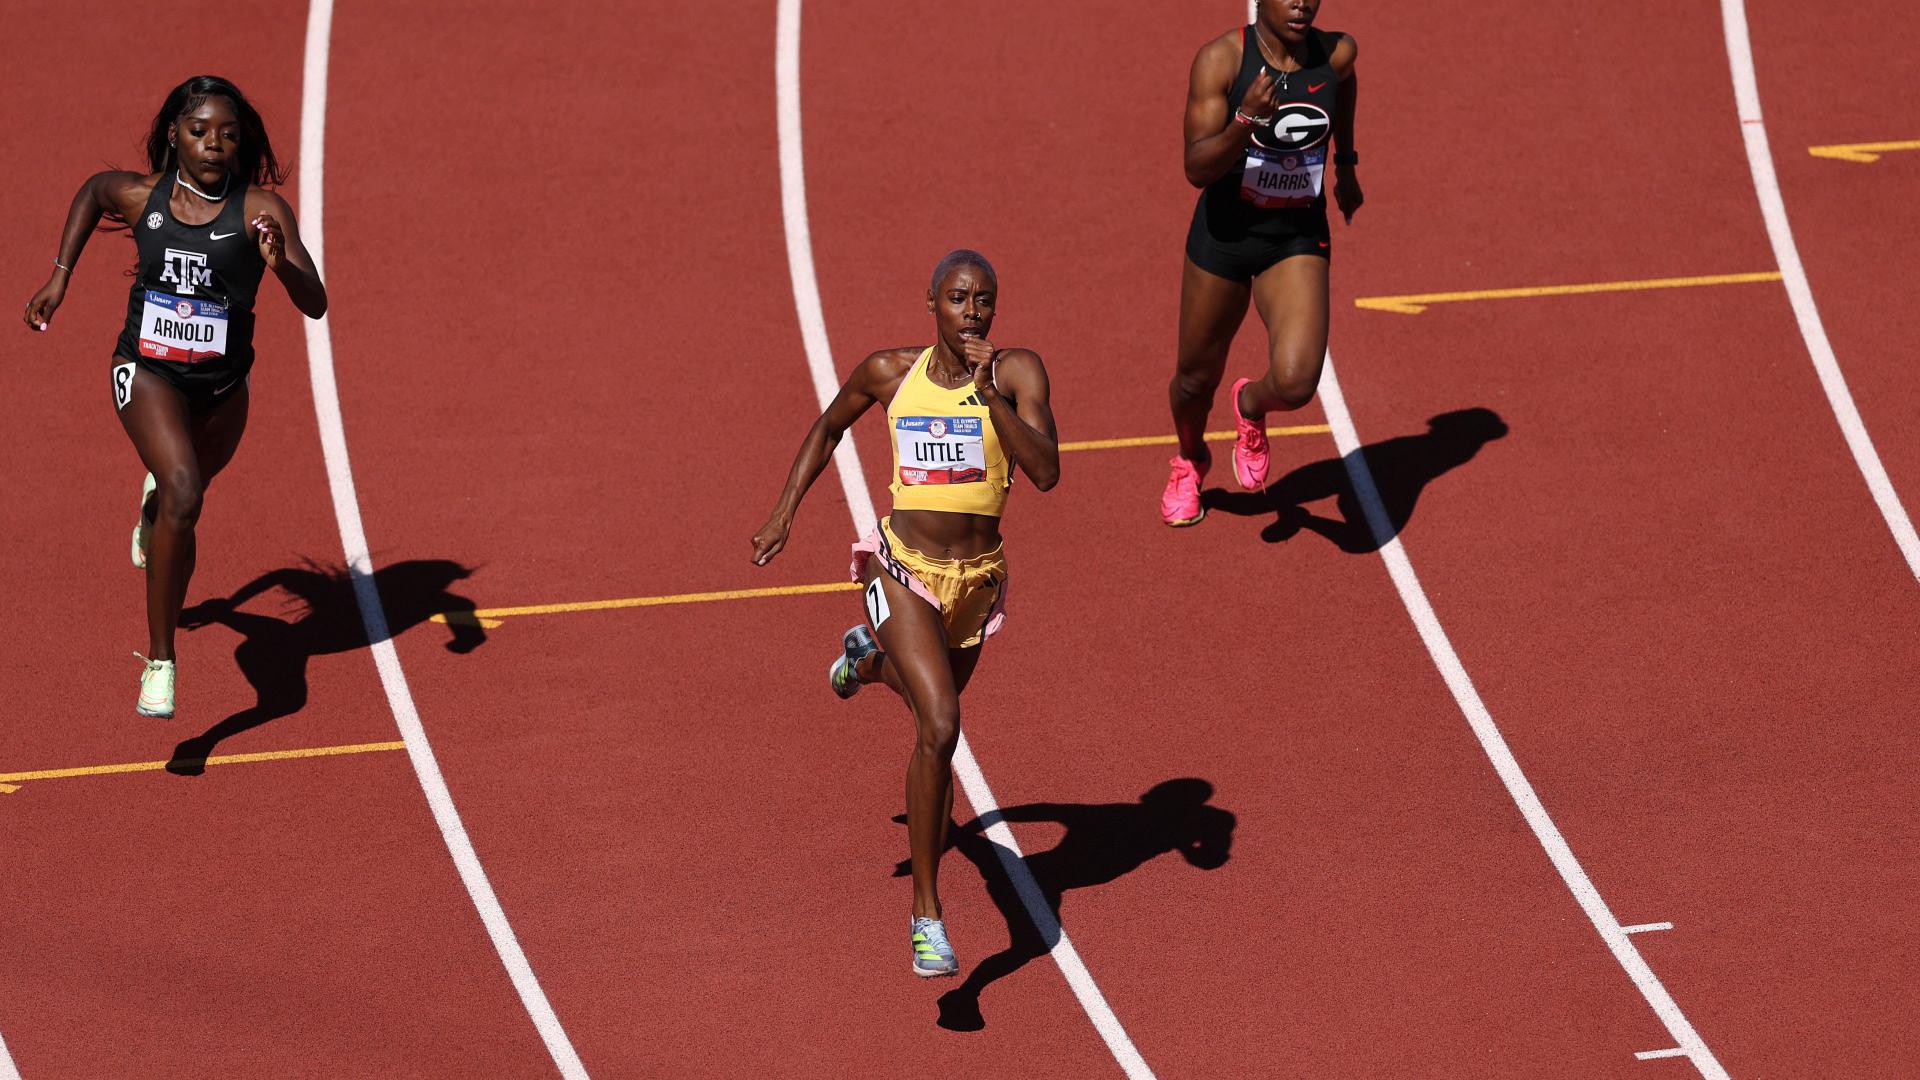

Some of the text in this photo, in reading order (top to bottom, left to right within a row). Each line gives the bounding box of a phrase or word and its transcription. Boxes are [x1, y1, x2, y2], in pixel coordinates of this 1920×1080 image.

[1258, 171, 1311, 190] HARRIS
[153, 317, 214, 342] ARNOLD
[116, 367, 130, 404] 8
[915, 442, 965, 461] LITTLE
[869, 583, 880, 624] 7
